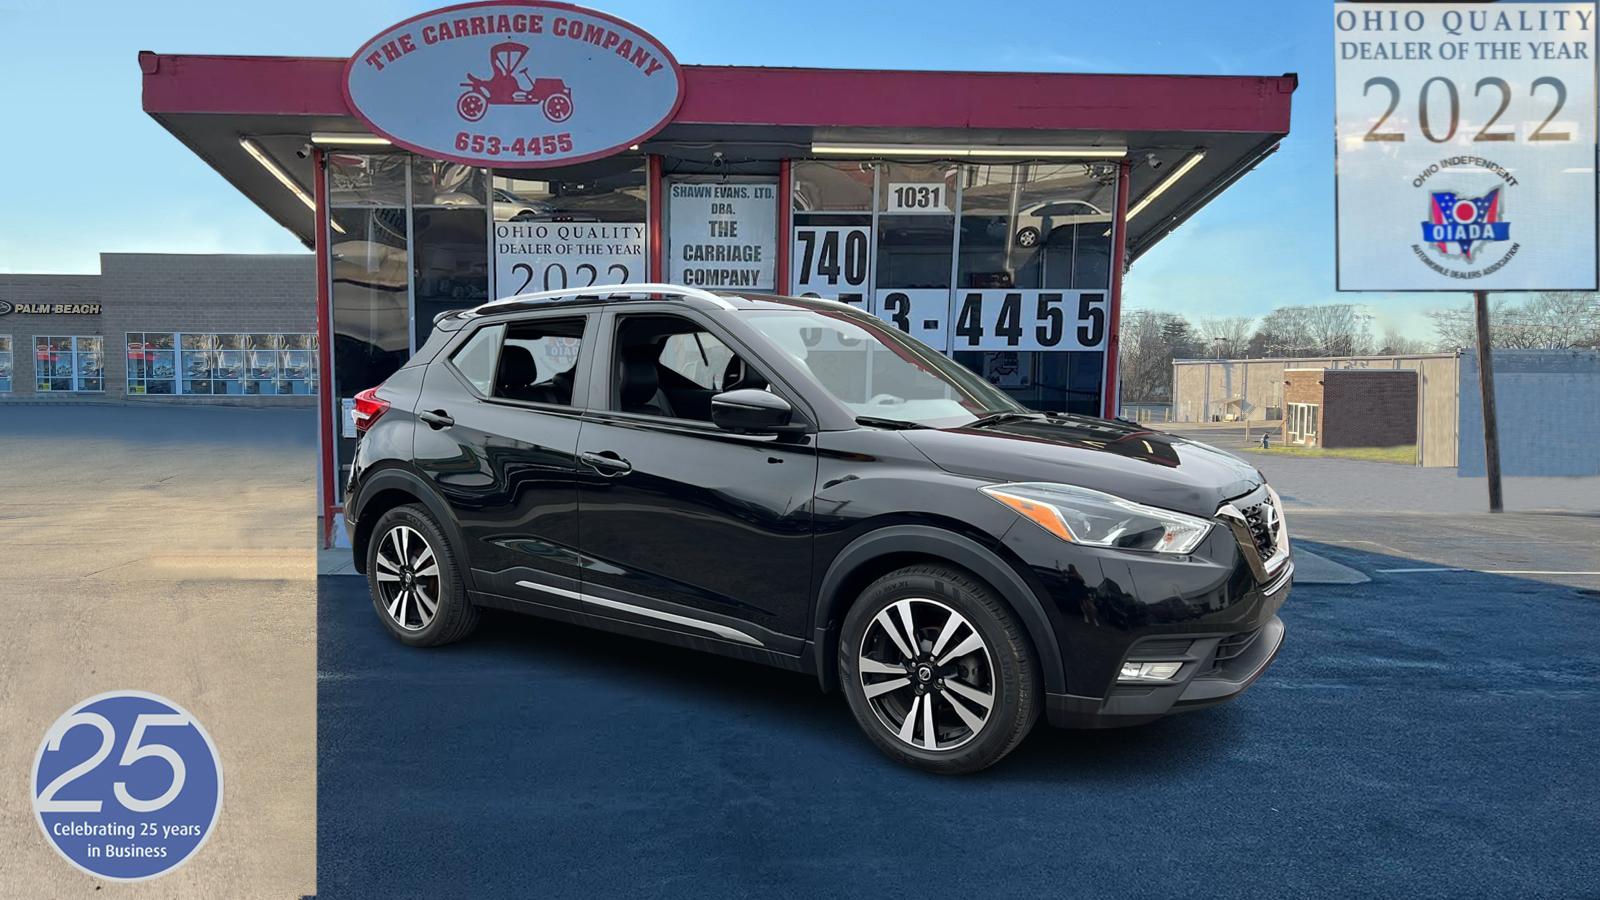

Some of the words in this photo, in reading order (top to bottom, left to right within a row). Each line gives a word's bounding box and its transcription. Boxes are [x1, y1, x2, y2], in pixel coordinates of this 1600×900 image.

[1336, 9, 1425, 32] OHIO
[1441, 9, 1593, 36] QUALITY
[365, 33, 417, 72] THE
[422, 14, 544, 46] CARRIAGE
[552, 16, 664, 78] COMPANY
[1340, 41, 1433, 60] DEALER
[1438, 41, 1470, 60] OF
[1475, 41, 1522, 60] THE
[1528, 41, 1589, 60] YEAR
[1362, 75, 1571, 144] 2022
[455, 131, 573, 156] 653-4455
[1412, 164, 1440, 188] OHIO
[1439, 155, 1520, 187] INDEPENDENT
[672, 186, 713, 199] SHAWN
[894, 186, 940, 208] 1031
[711, 203, 736, 215] DBA.
[497, 226, 549, 239] OHIO
[557, 226, 645, 241] QUALITY
[708, 220, 738, 237] THE
[1432, 224, 1495, 241] OIADA
[499, 243, 552, 255] DEALER
[555, 244, 573, 255] OF
[576, 244, 603, 255] THE
[605, 244, 642, 255] YEAR
[683, 244, 762, 262] CARRIAGE
[797, 230, 868, 286] 740
[510, 263, 632, 300] 2022
[682, 268, 761, 287] COMPANY
[1450, 270, 1482, 280] DEALERS
[15, 304, 50, 314] PALM
